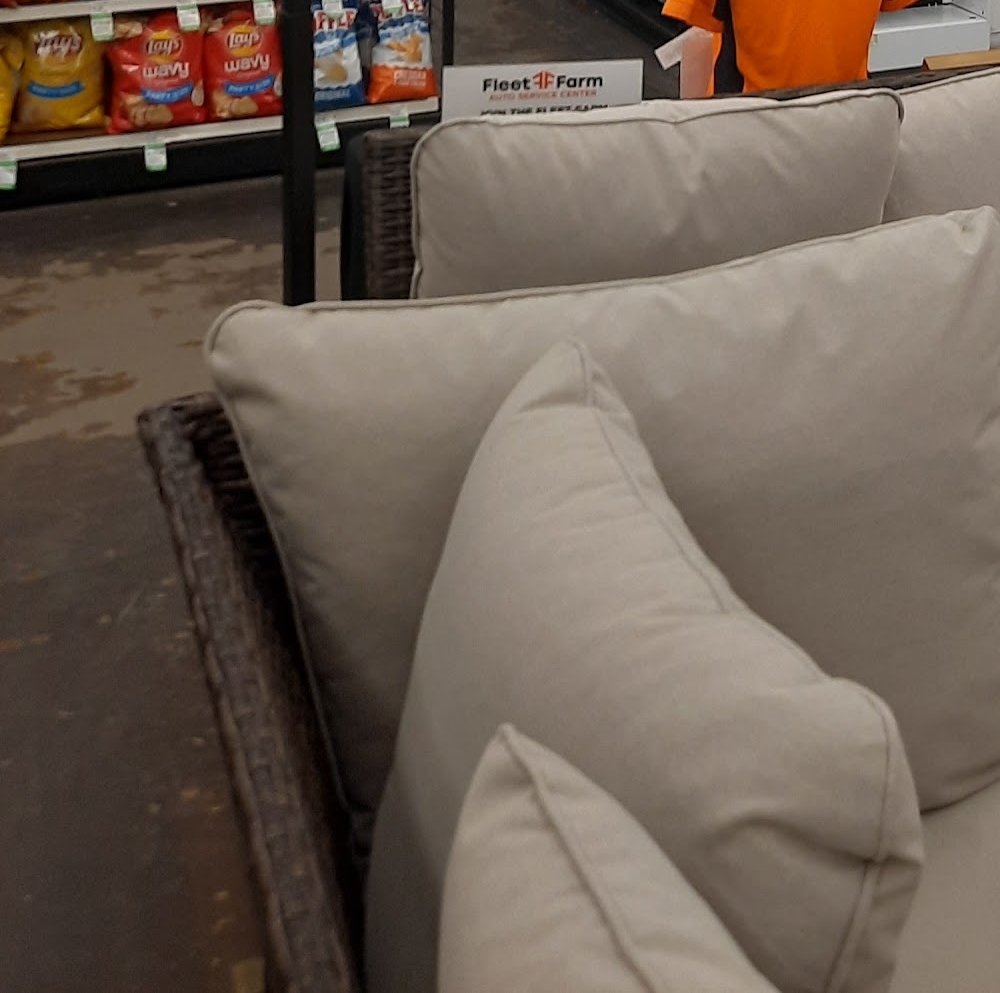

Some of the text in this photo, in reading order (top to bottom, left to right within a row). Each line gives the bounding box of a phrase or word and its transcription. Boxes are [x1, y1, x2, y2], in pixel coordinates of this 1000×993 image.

[142, 62, 190, 80] wavy
[224, 54, 271, 73] wavy
[482, 75, 603, 93] Fleet Farm
[559, 89, 598, 99] CENTER
